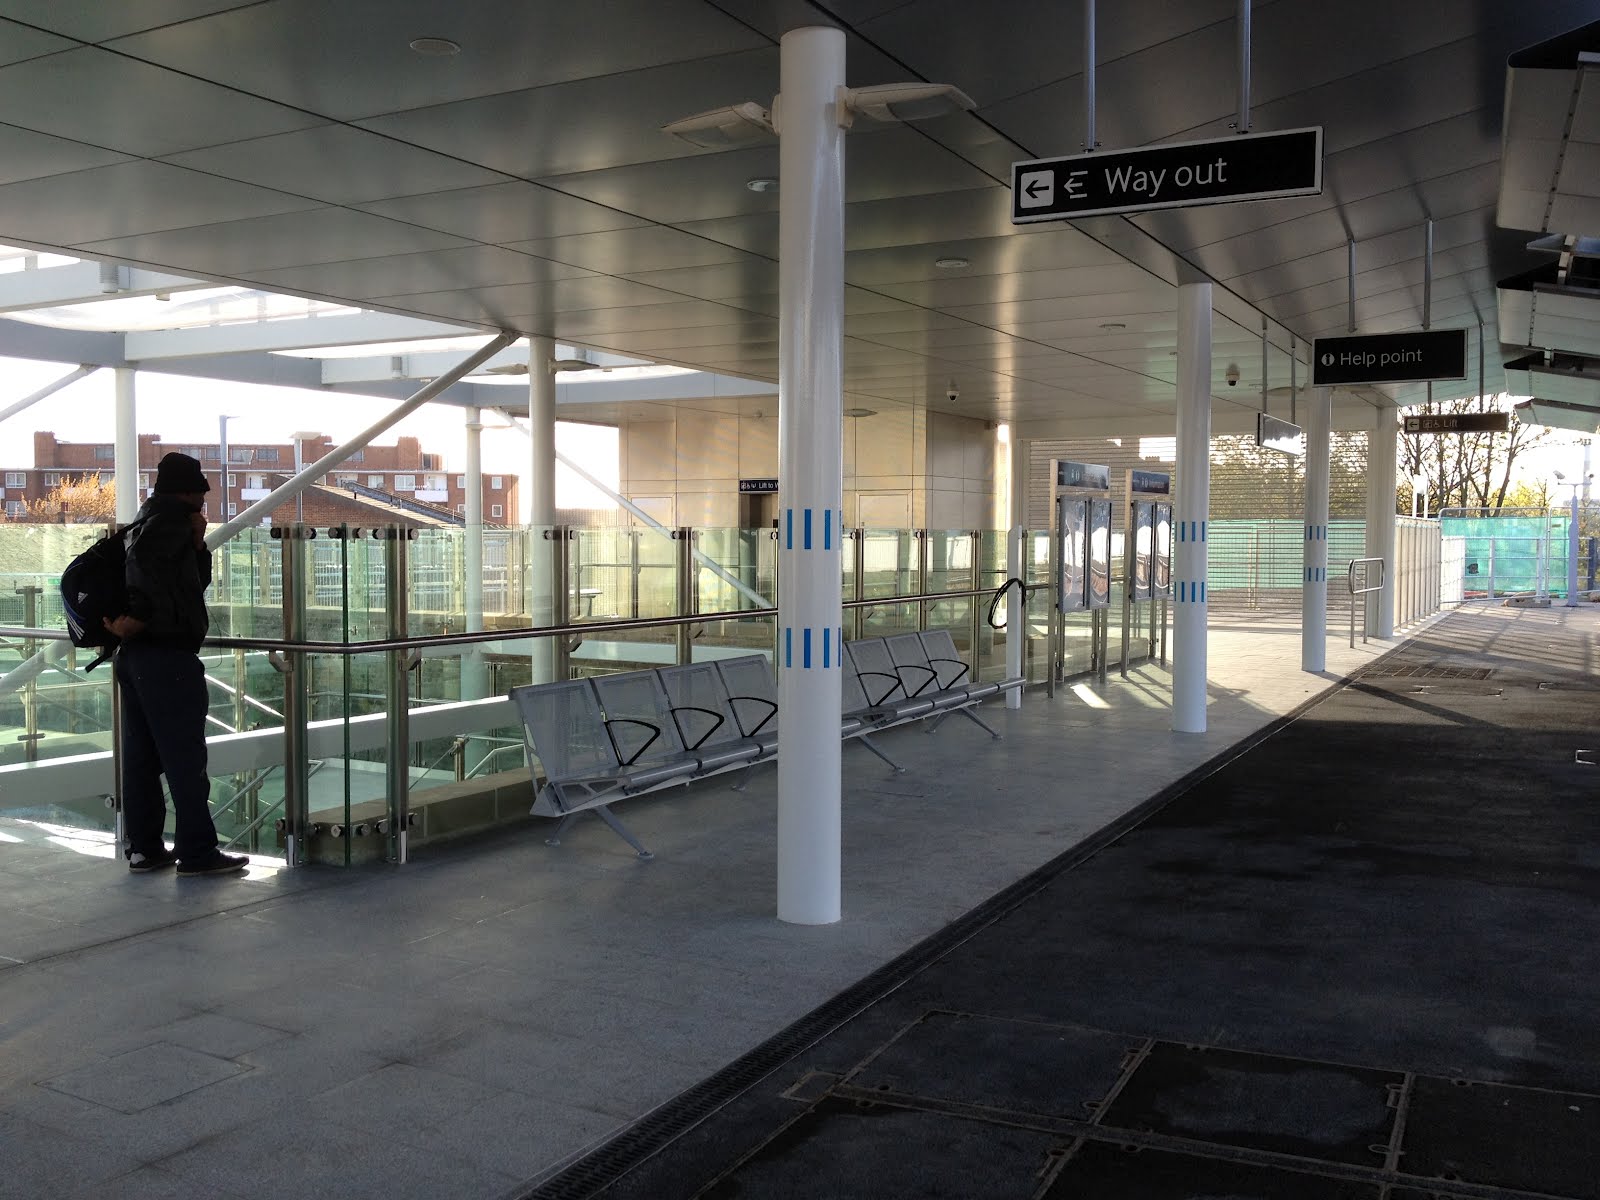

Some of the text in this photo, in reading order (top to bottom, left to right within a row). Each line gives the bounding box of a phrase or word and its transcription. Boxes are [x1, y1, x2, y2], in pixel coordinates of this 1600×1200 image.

[1104, 157, 1228, 197] Way out
[1340, 348, 1423, 368] Help point
[1443, 418, 1458, 428] Lift
